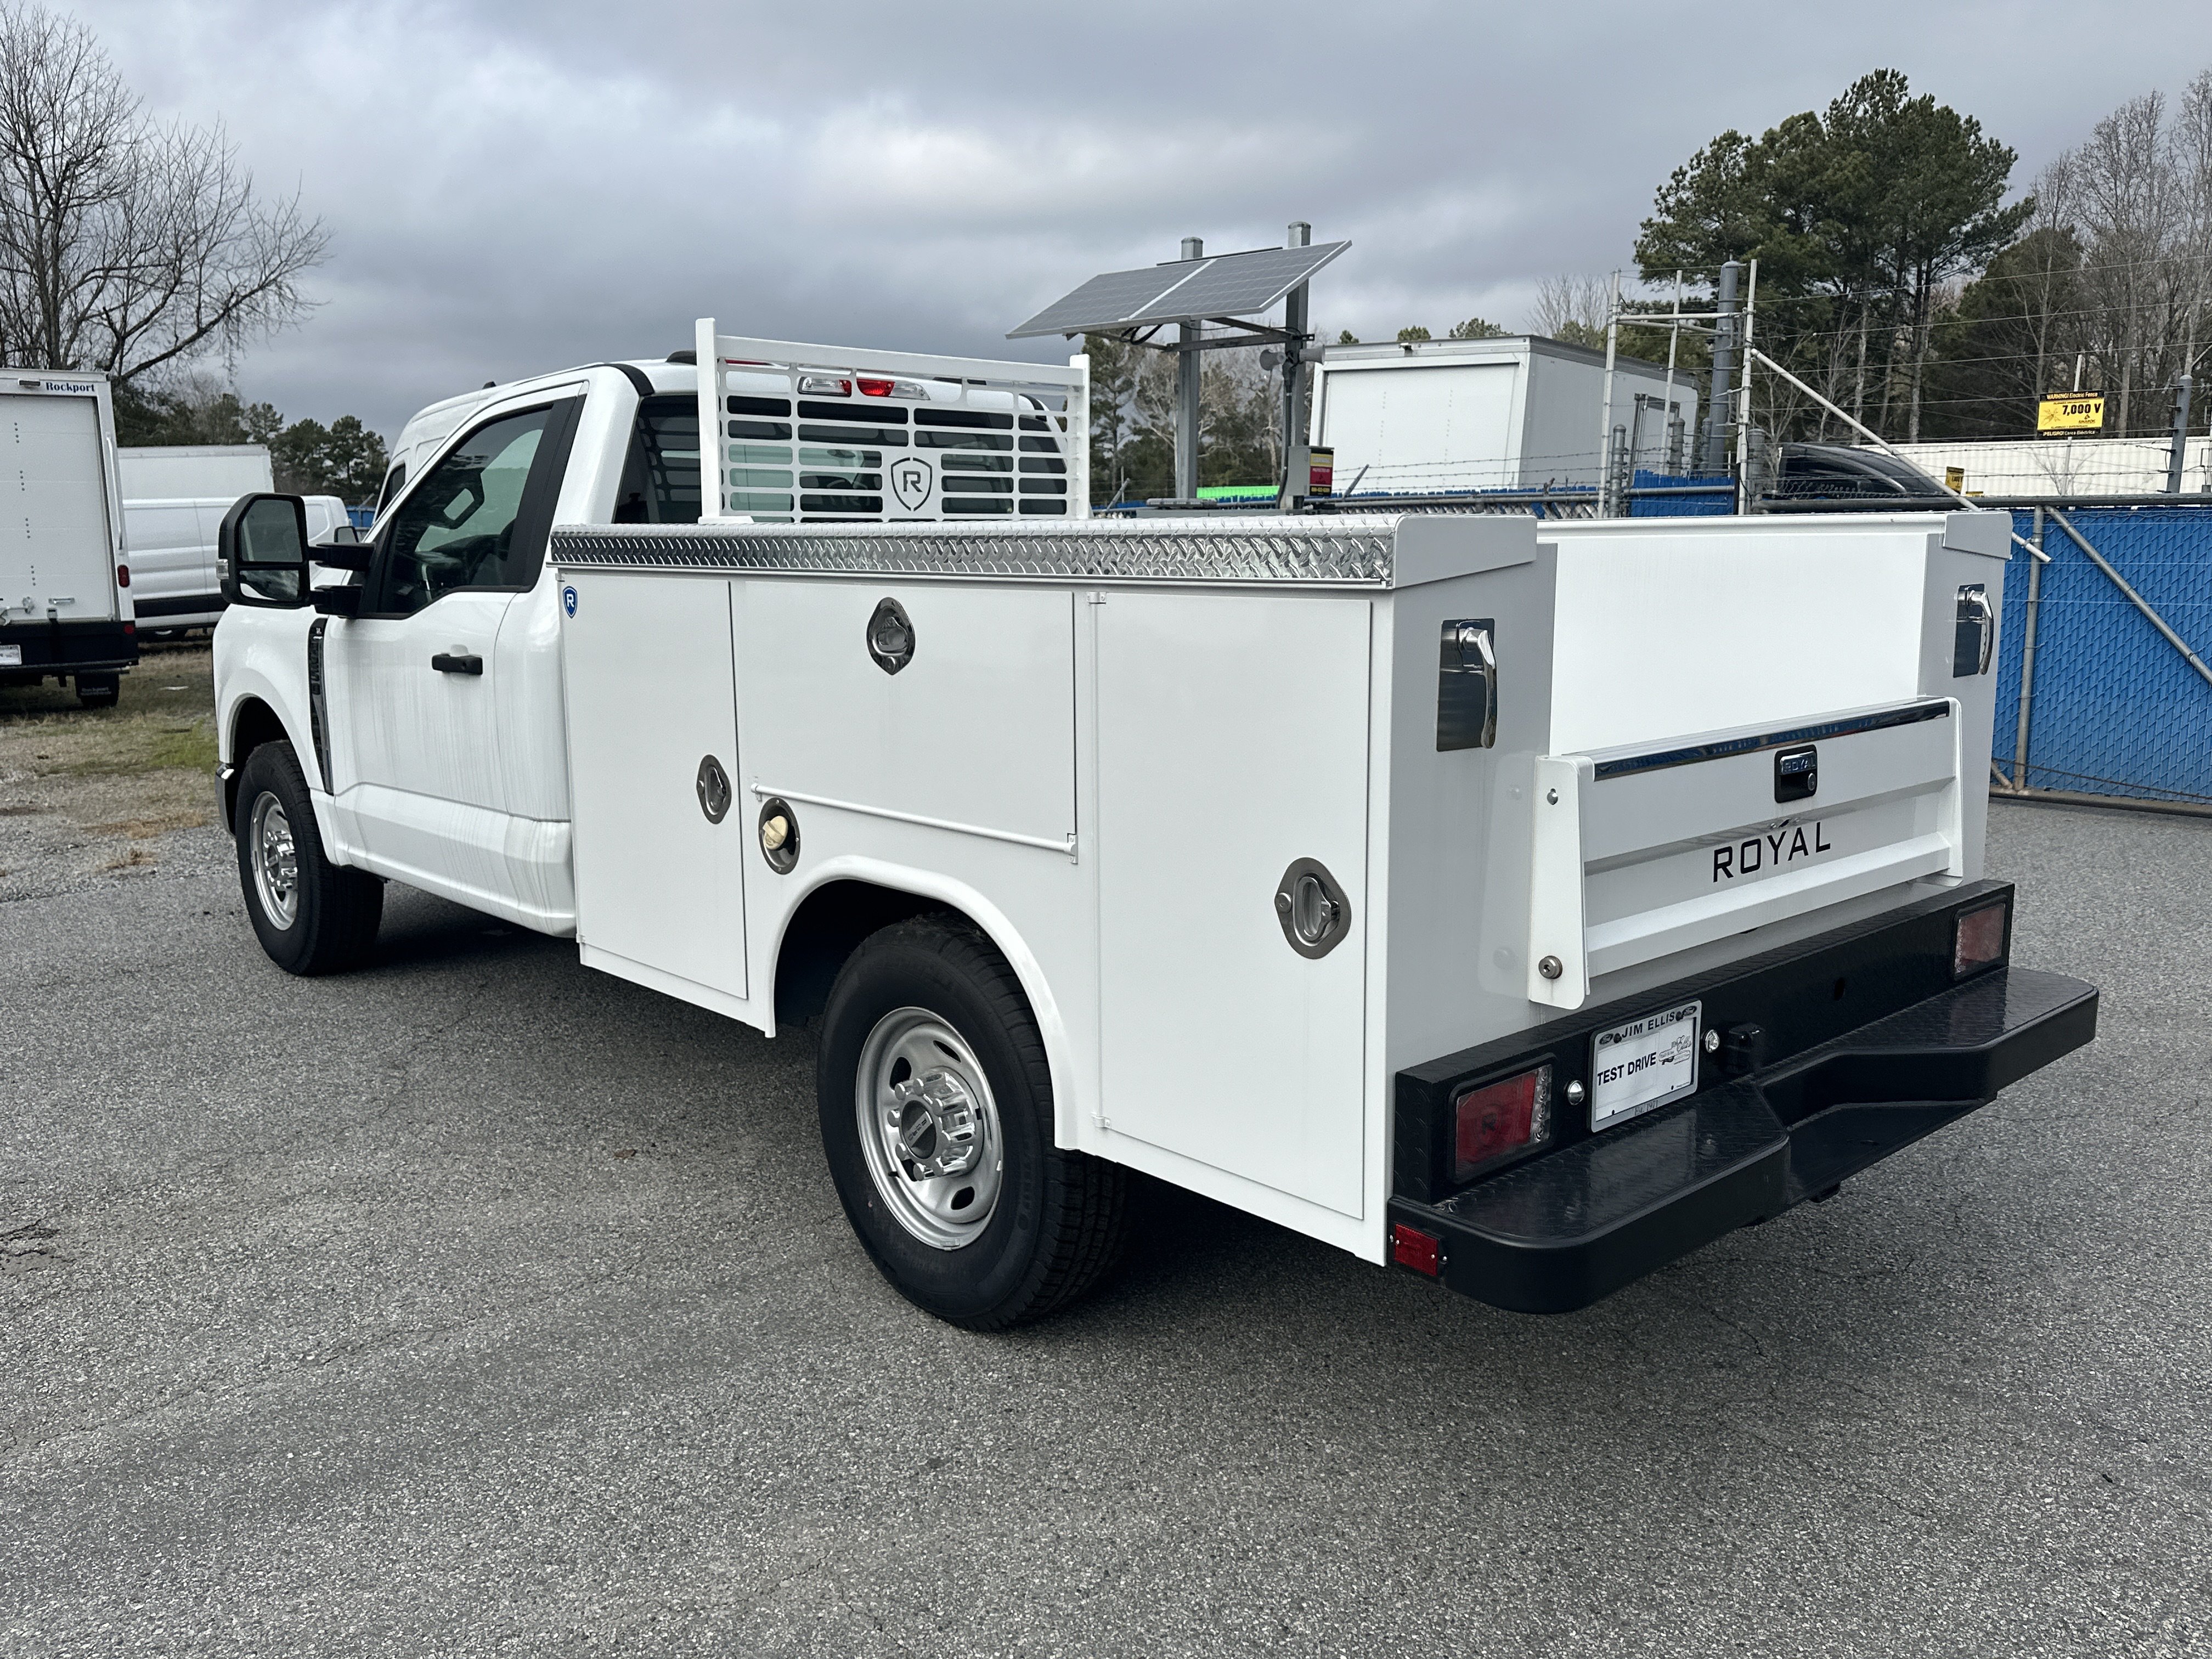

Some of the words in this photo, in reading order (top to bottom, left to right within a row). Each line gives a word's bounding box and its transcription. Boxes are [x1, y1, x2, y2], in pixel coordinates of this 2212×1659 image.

[46, 382, 95, 393] Rockport
[2062, 404, 2091, 416] 7,000
[2094, 403, 2101, 413] V
[903, 471, 923, 492] R
[566, 594, 574, 607] R
[1713, 822, 1831, 882] ROYAL
[1622, 1023, 1643, 1038] JIM
[1647, 1012, 1675, 1030] ELLIS
[1597, 1064, 1624, 1086] TEST
[1628, 1052, 1657, 1075] DRIVE
